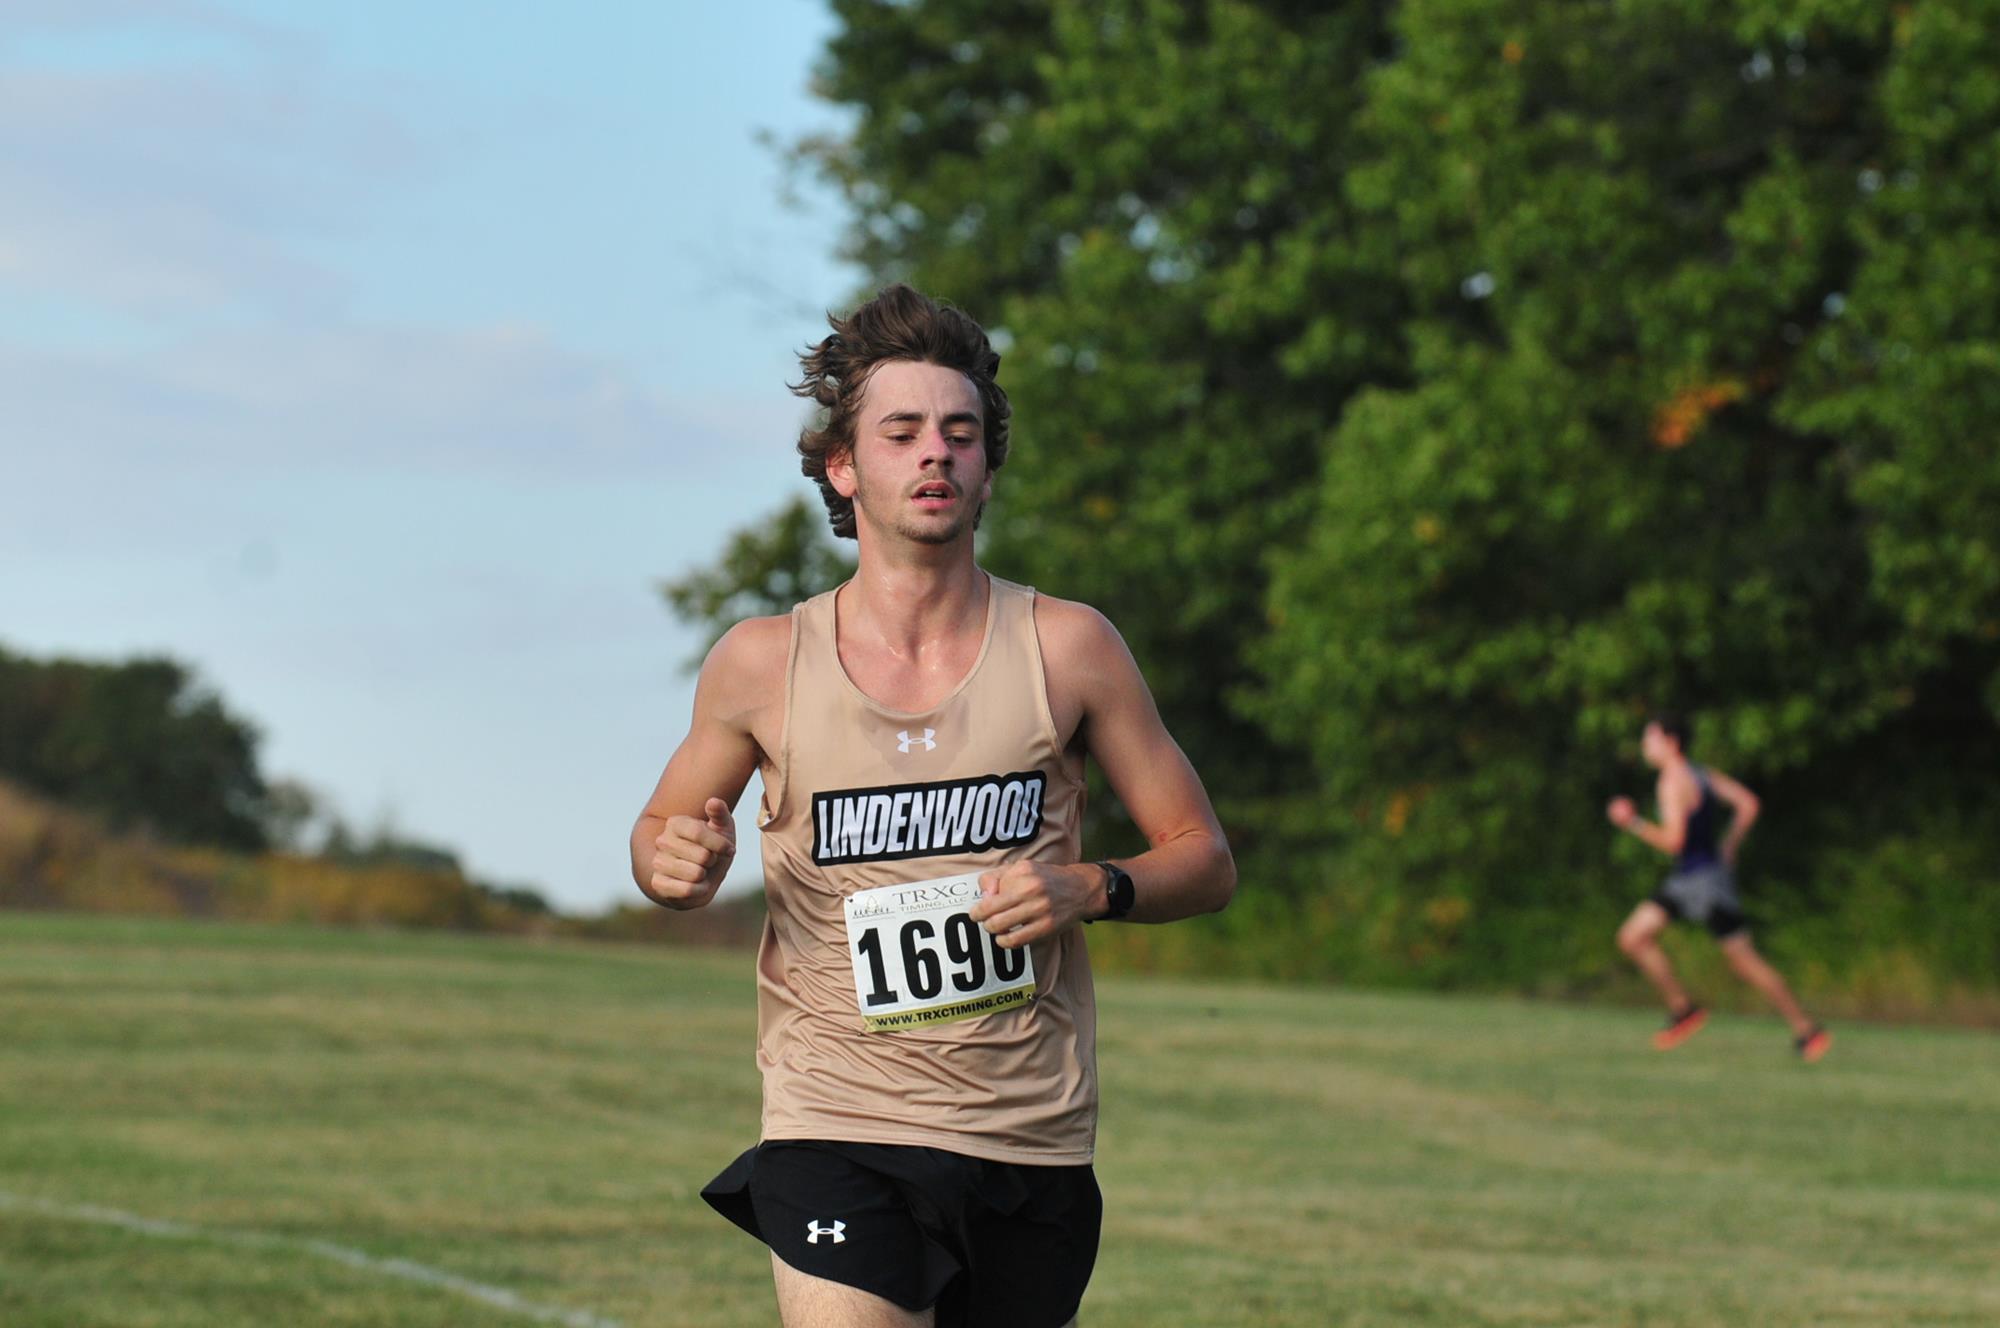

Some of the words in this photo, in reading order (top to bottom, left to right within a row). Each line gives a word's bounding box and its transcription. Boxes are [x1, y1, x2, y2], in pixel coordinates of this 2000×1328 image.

[818, 778, 1043, 859] LINDENWOOD
[892, 882, 969, 905] TRXC
[876, 990, 1024, 1026] WWW.TRXCTIMING.COM
